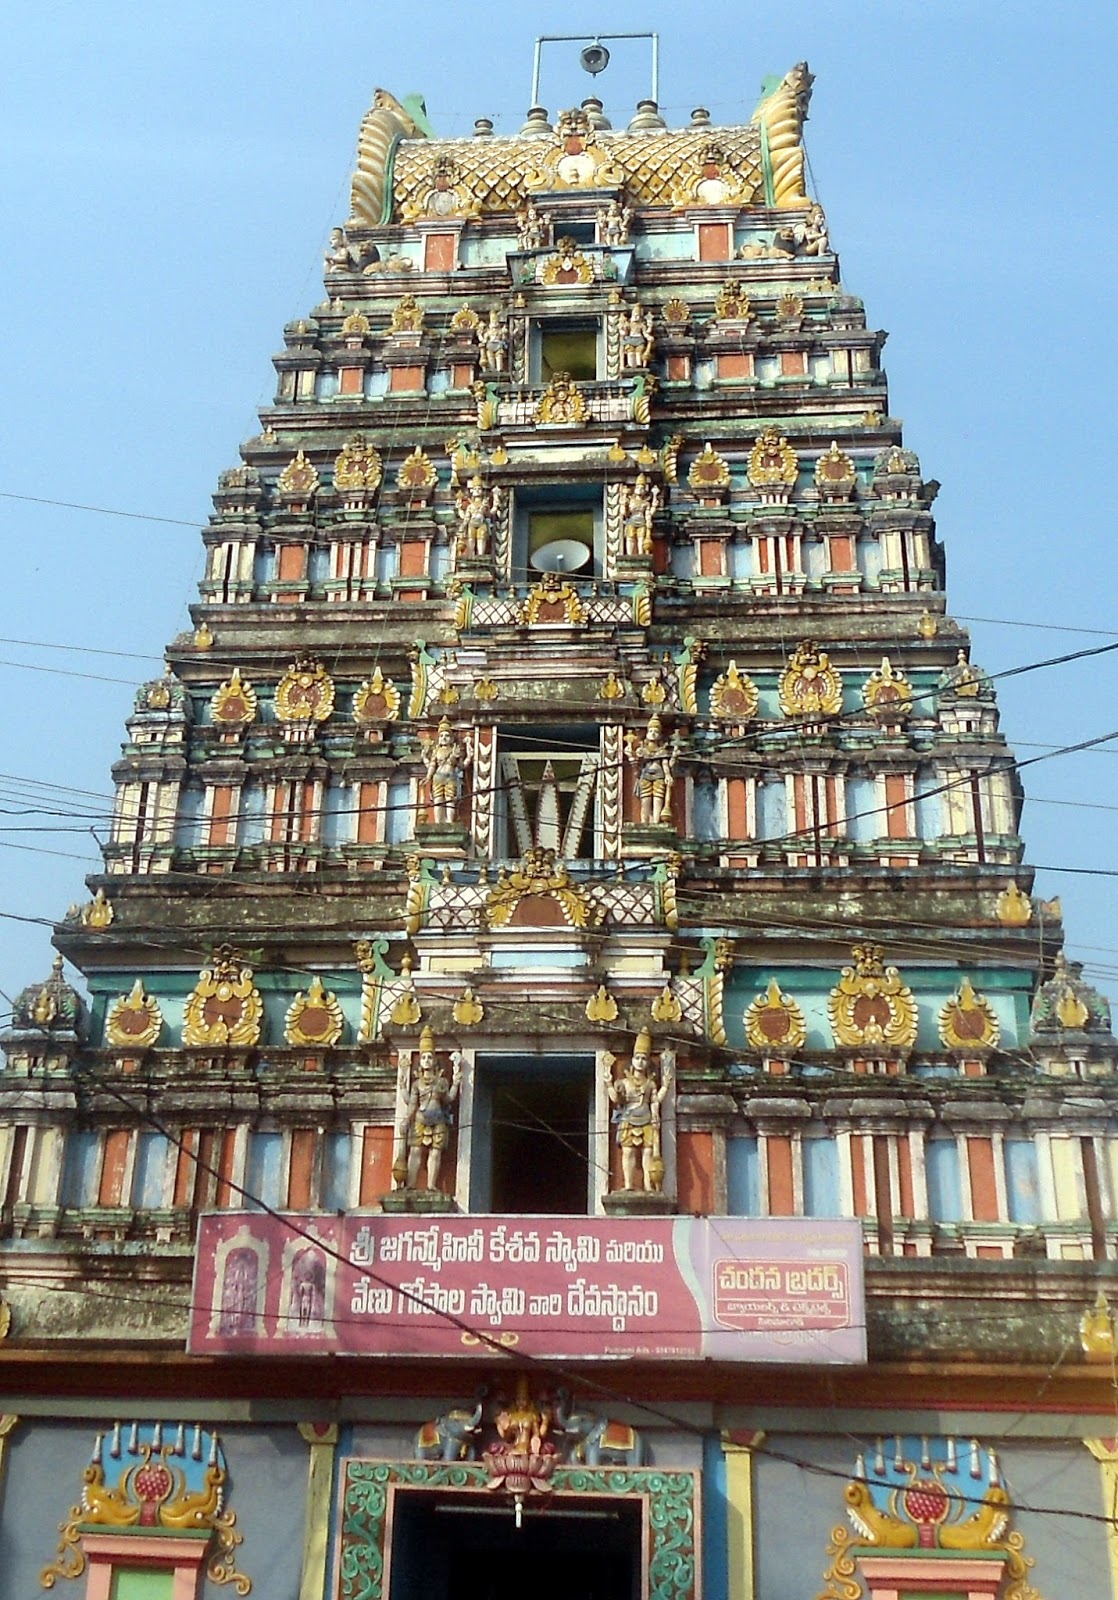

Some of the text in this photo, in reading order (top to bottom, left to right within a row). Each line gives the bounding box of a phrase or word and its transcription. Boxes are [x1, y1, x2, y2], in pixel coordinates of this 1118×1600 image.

[350, 1226, 375, 1266] శ్రీ
[489, 1225, 541, 1263] కేశవ
[545, 1231, 600, 1273] స్వామి
[606, 1239, 664, 1263] మరియు
[351, 1276, 393, 1314] వేణు
[397, 1277, 466, 1315] గోపాల
[470, 1283, 526, 1325] స్వామి
[529, 1294, 562, 1315] వారి
[719, 1265, 844, 1299] చందన బ్రదర్స్
